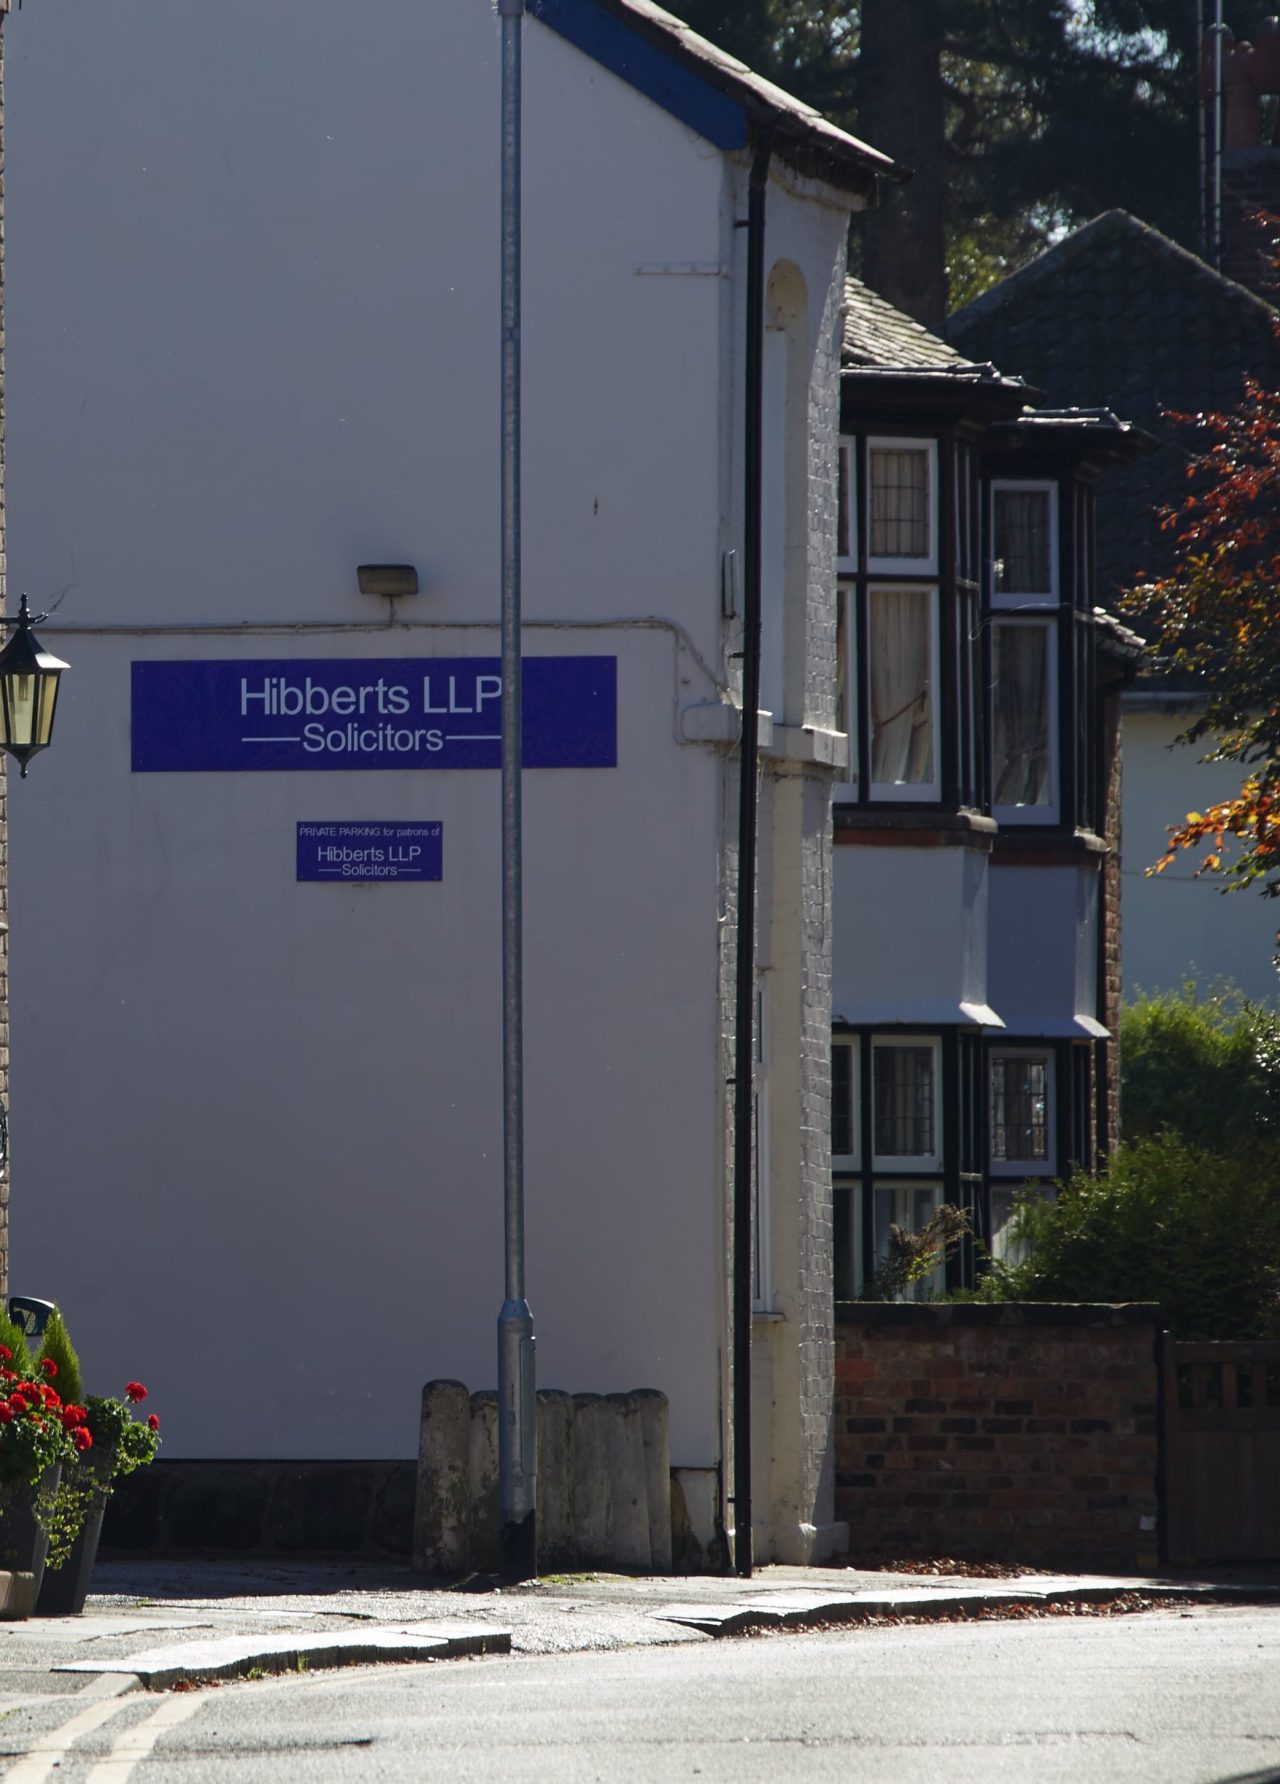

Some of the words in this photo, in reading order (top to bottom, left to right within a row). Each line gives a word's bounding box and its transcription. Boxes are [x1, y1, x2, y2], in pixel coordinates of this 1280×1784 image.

[241, 677, 410, 716] Hibberts
[424, 676, 502, 714] LLP
[303, 723, 444, 752] Solicitors
[300, 828, 336, 836] PRIVATE
[340, 827, 380, 836] PARKING
[383, 827, 394, 836] for
[397, 828, 429, 837] patrons
[431, 827, 440, 836] of
[318, 846, 384, 861] Hibberts
[389, 846, 421, 861] LLP
[342, 864, 397, 876] Solicitors
